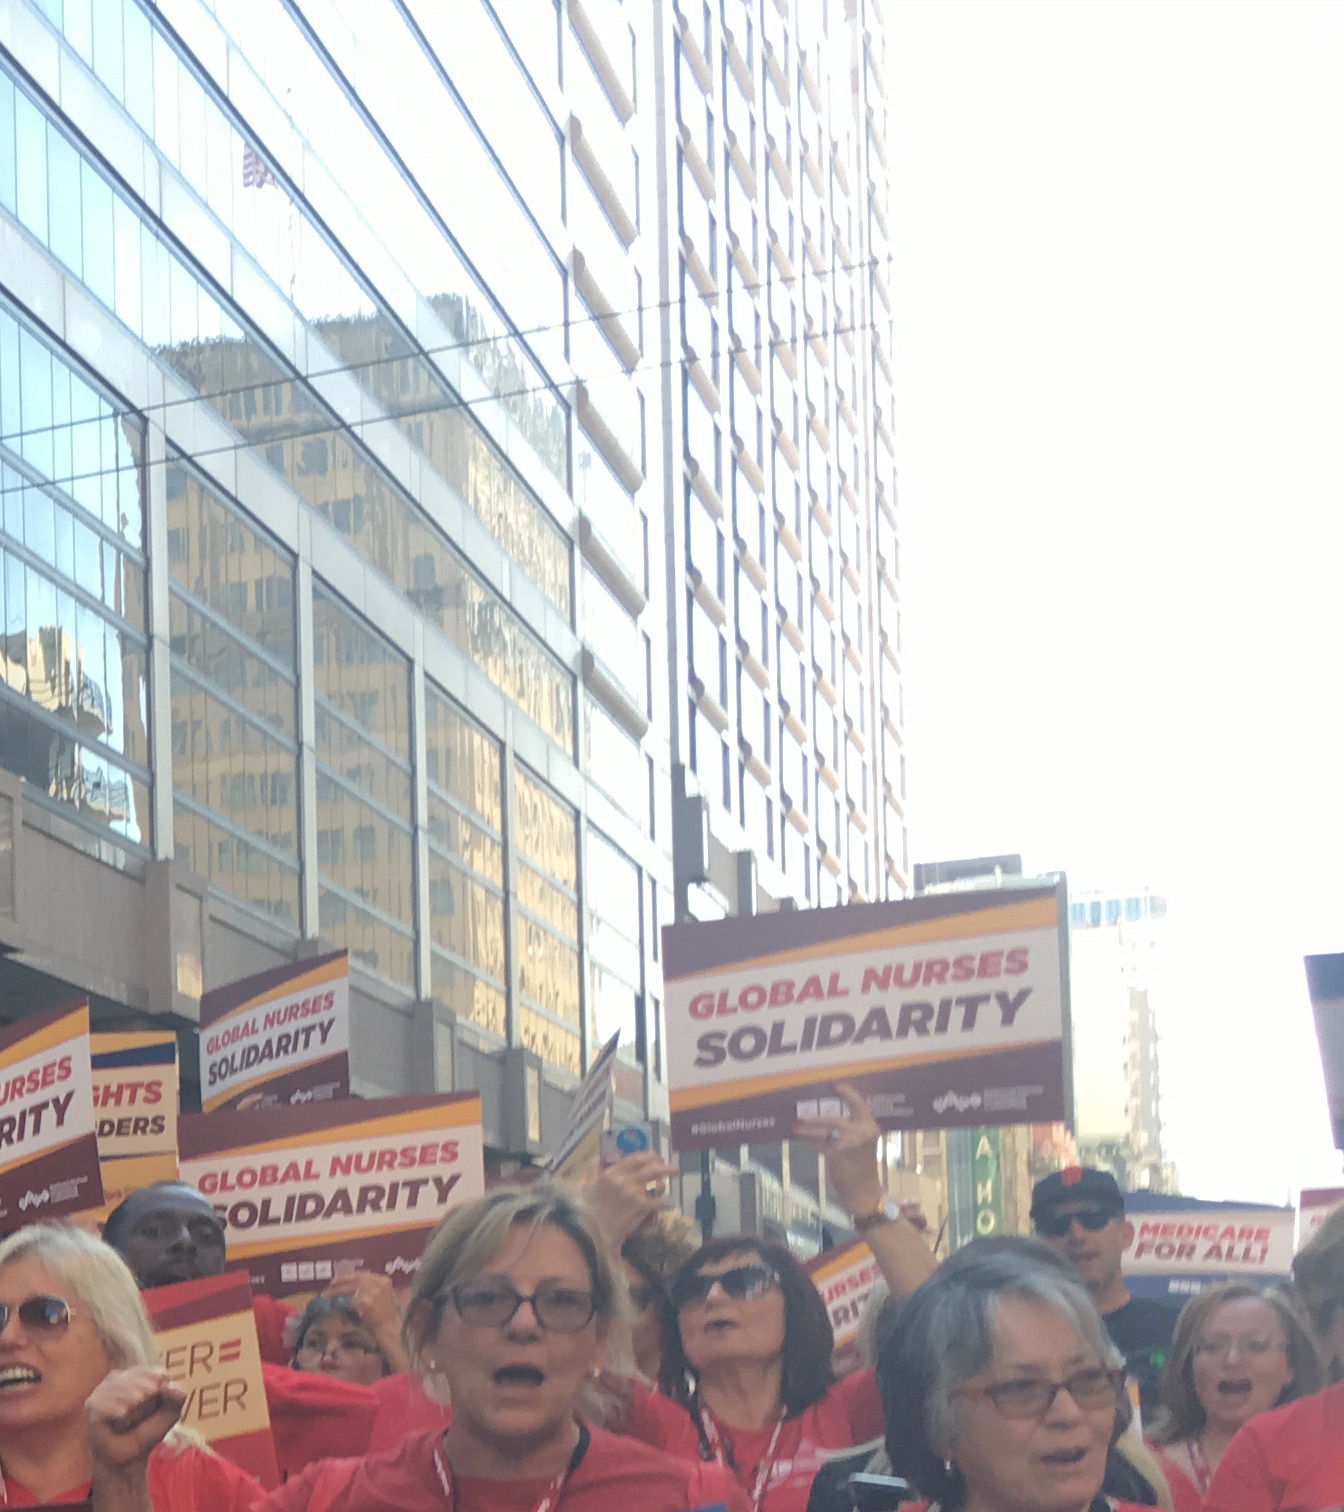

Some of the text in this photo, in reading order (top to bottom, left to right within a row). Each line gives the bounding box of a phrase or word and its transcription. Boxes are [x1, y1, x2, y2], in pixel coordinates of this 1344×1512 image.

[689, 947, 1030, 1020] GLOBAL NURSES
[206, 990, 335, 1056] GLOBAL NURSES
[208, 1016, 336, 1086] SOLIDARITY
[694, 988, 1033, 1068] SOLIDARITY
[93, 1080, 163, 1108] GHTS
[96, 1115, 165, 1137] DERS
[198, 1140, 460, 1195] GLOBAL NURSES
[213, 1171, 462, 1231] SOLIDARITY
[1135, 1241, 1197, 1261] FOR
[1139, 1222, 1271, 1243] MEDICARE
